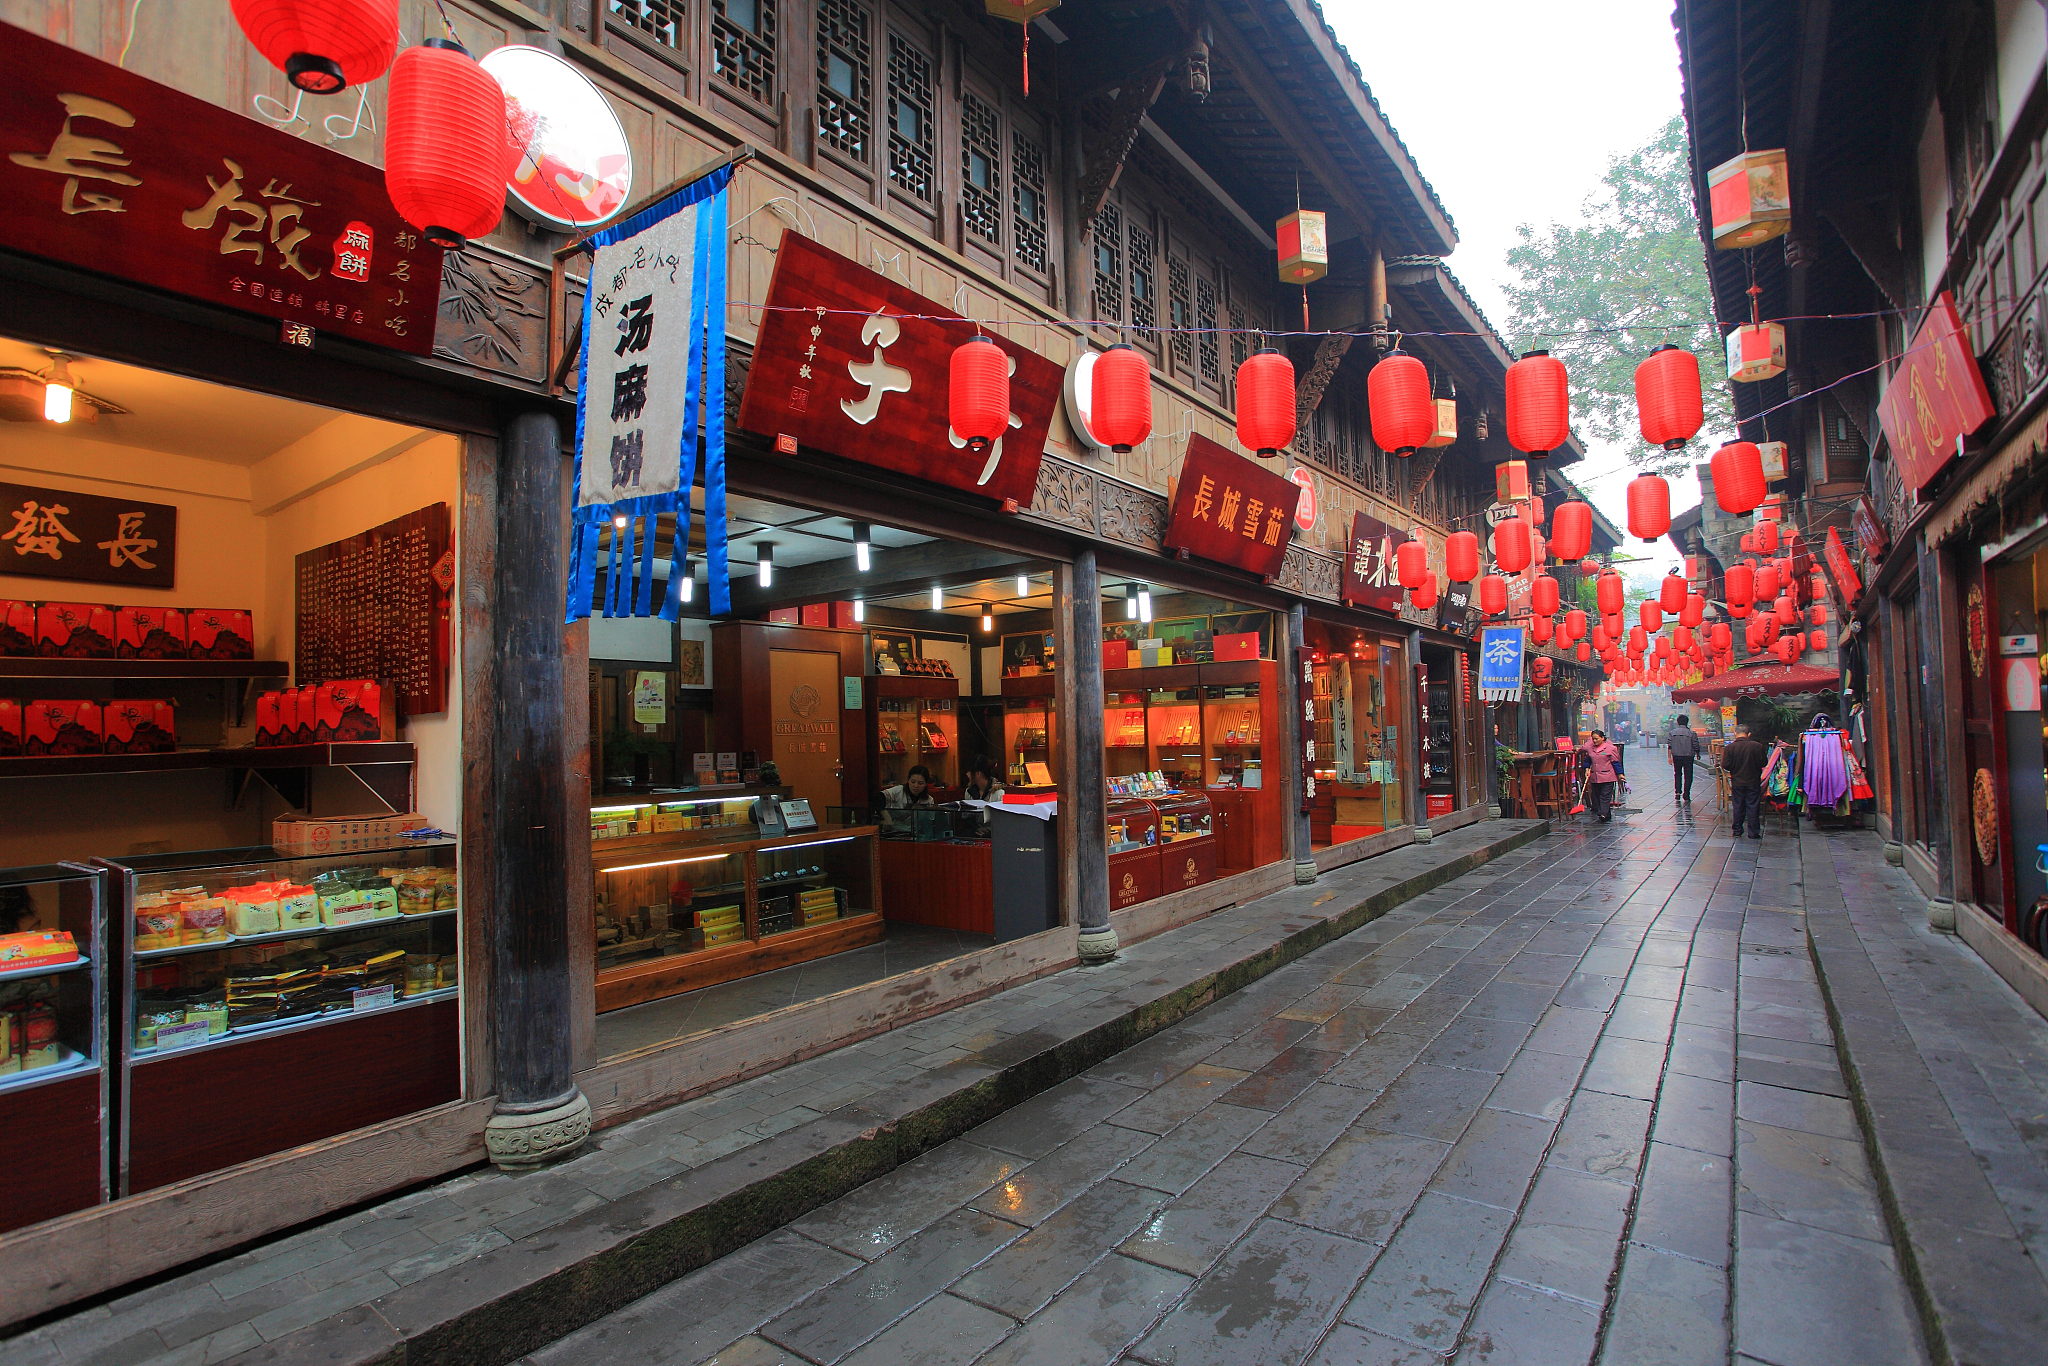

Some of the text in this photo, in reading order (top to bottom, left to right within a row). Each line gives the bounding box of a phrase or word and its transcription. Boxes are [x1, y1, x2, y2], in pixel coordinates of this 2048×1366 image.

[339, 229, 370, 277] 麻餅
[385, 229, 417, 337] 都名小吃
[595, 245, 680, 319] 成都名小吃
[287, 324, 313, 347] 福
[1192, 474, 1285, 547] 長城雪茄
[1509, 578, 1529, 591] BAR
[1485, 638, 1519, 666] 茶
